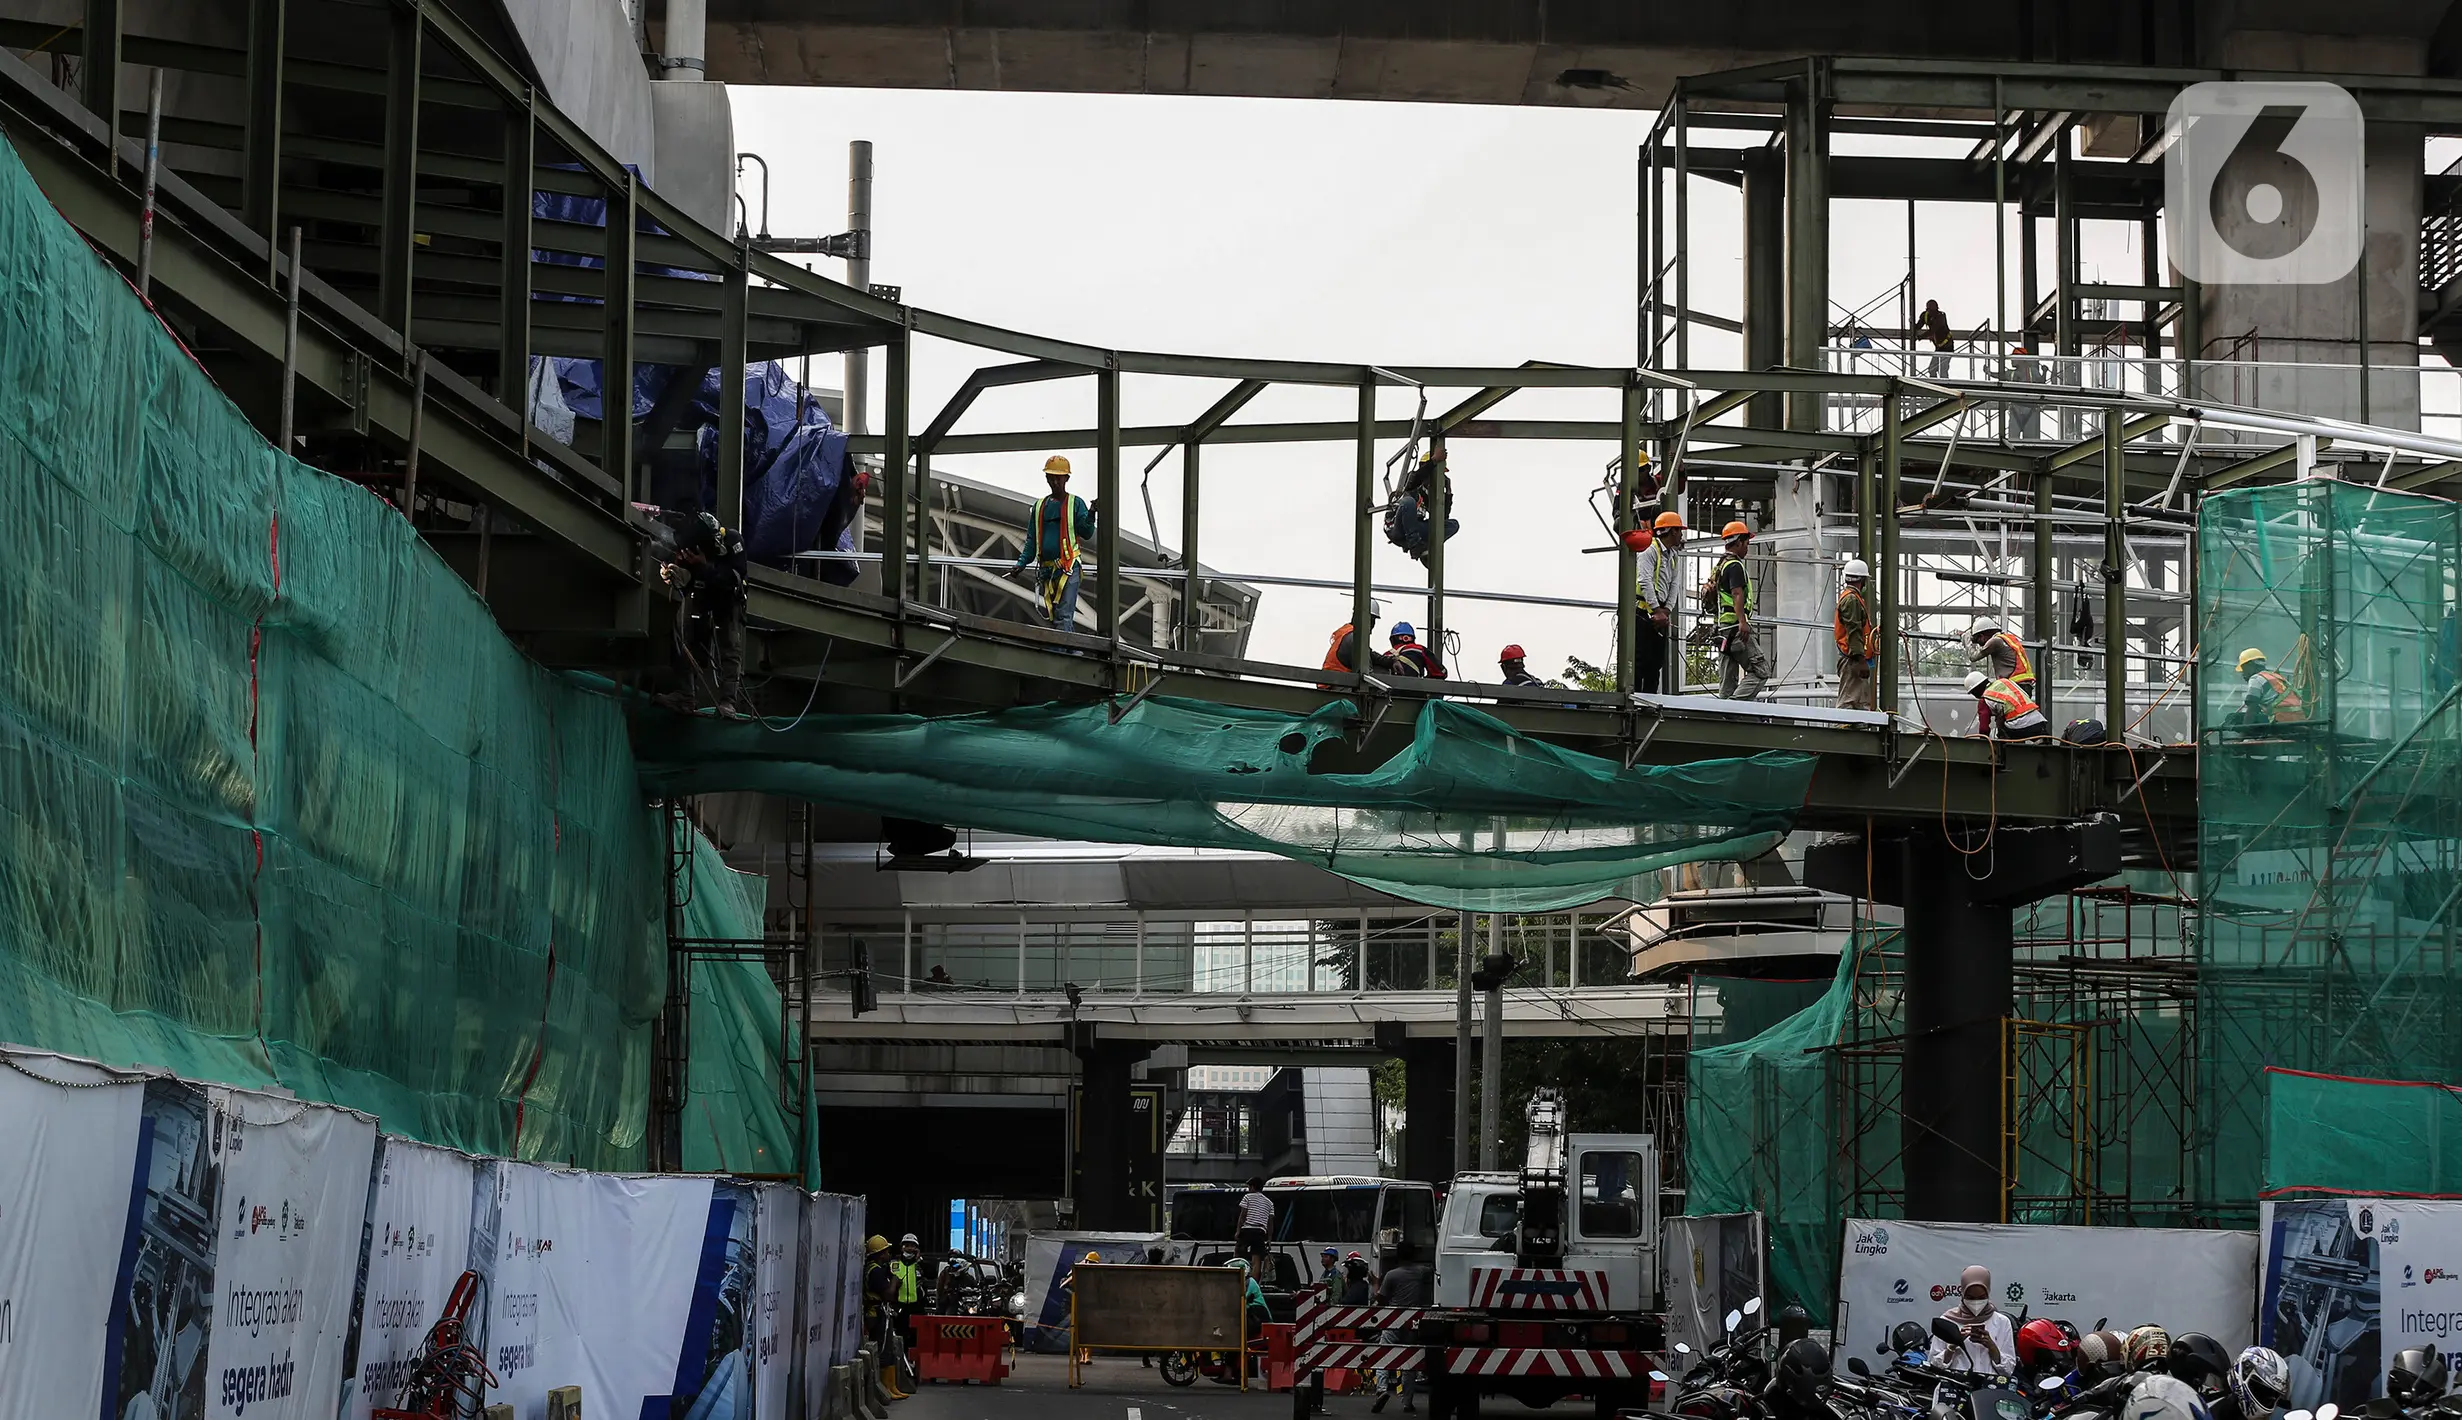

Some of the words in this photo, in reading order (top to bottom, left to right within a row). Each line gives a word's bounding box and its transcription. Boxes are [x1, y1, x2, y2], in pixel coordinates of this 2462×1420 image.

[1856, 1233, 1873, 1244] Jak
[1855, 1243, 1888, 1256] Lingko
[2044, 1291, 2077, 1301] Jakarta
[226, 1277, 283, 1338] Integrasi
[281, 1277, 304, 1324] akan
[222, 1364, 267, 1417] segera
[267, 1346, 295, 1400] hadir
